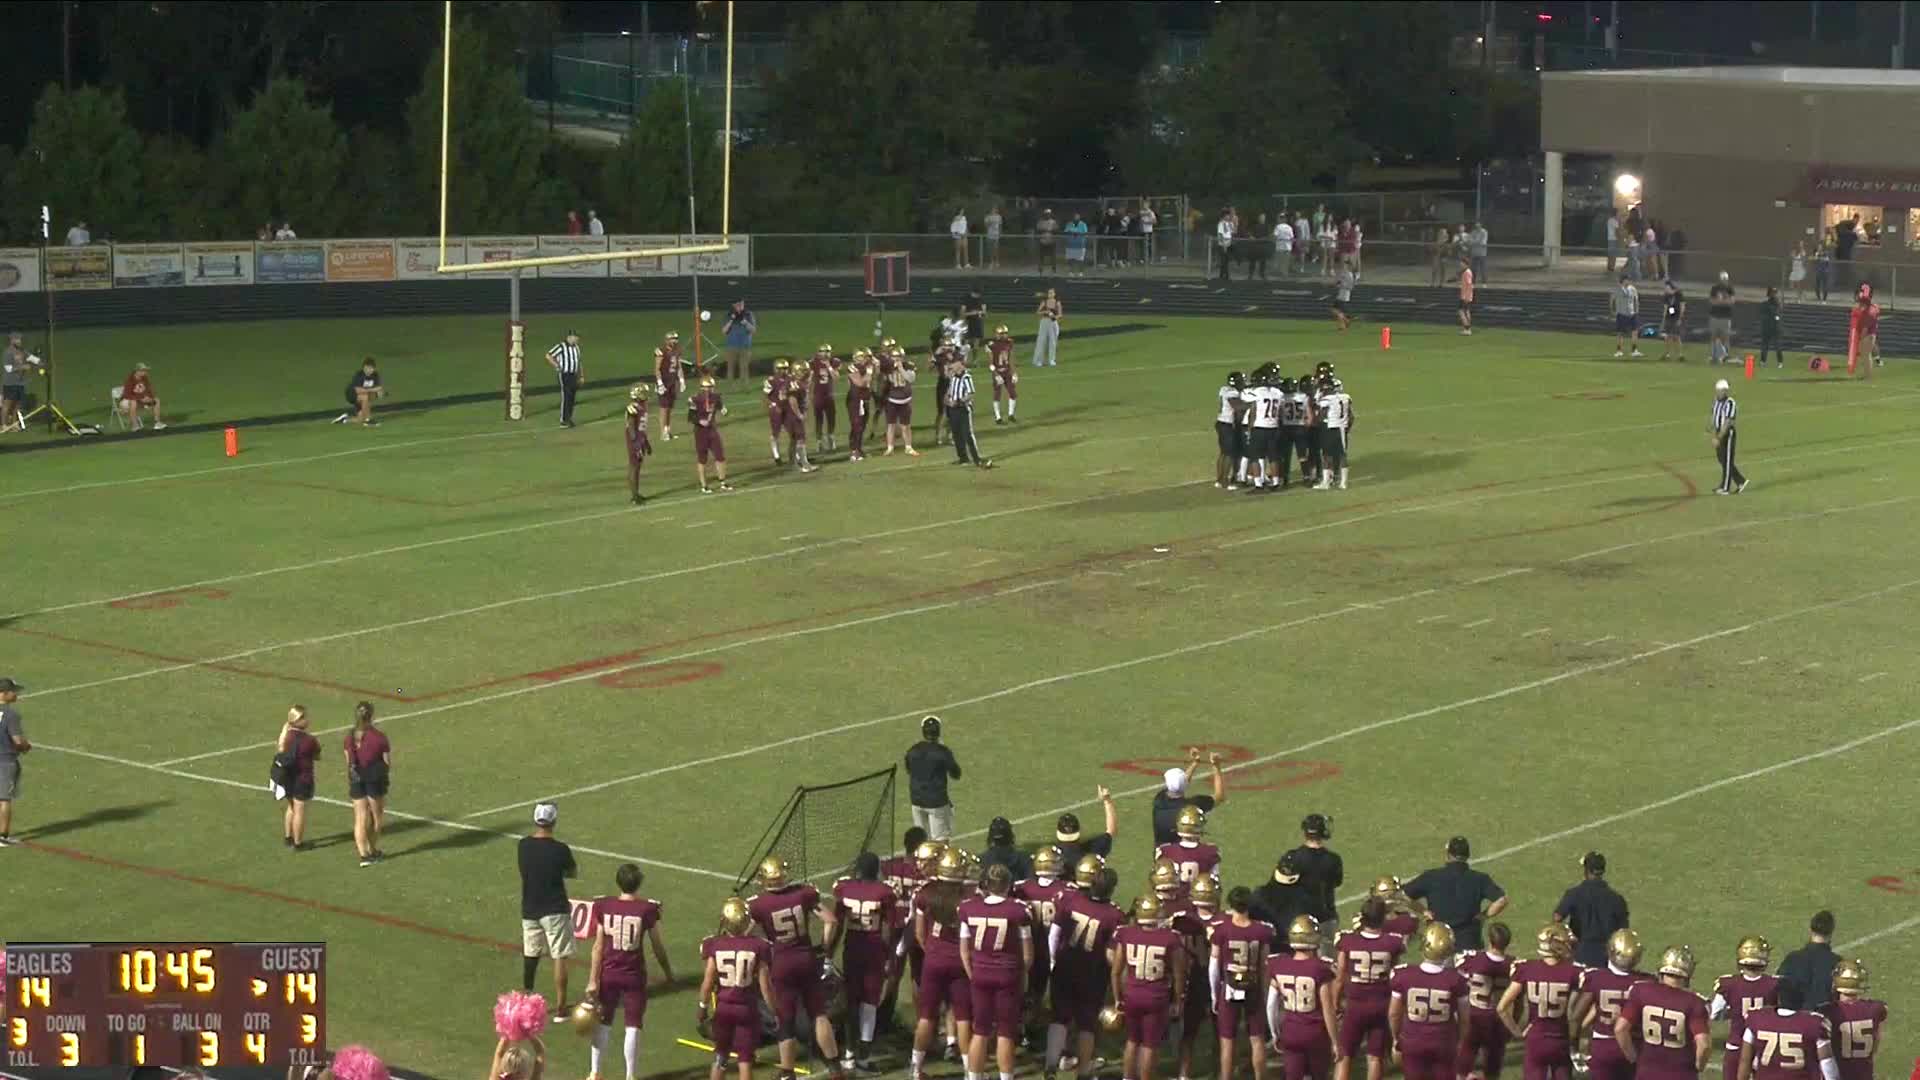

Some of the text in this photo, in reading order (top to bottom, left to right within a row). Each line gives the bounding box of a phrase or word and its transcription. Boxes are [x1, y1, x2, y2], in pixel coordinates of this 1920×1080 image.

[604, 914, 643, 952] 40
[771, 904, 807, 943] 51
[967, 916, 1008, 952] 77
[1071, 911, 1100, 953] 71
[715, 950, 757, 988] 50
[1126, 944, 1167, 981] 46
[1228, 940, 1260, 973] 31
[1275, 974, 1316, 1013] 58
[1407, 987, 1452, 1023] 65
[1527, 981, 1570, 1018] 45
[1642, 1005, 1687, 1049] 63
[1839, 1018, 1874, 1059] 15
[1757, 1029, 1806, 1070] 75
